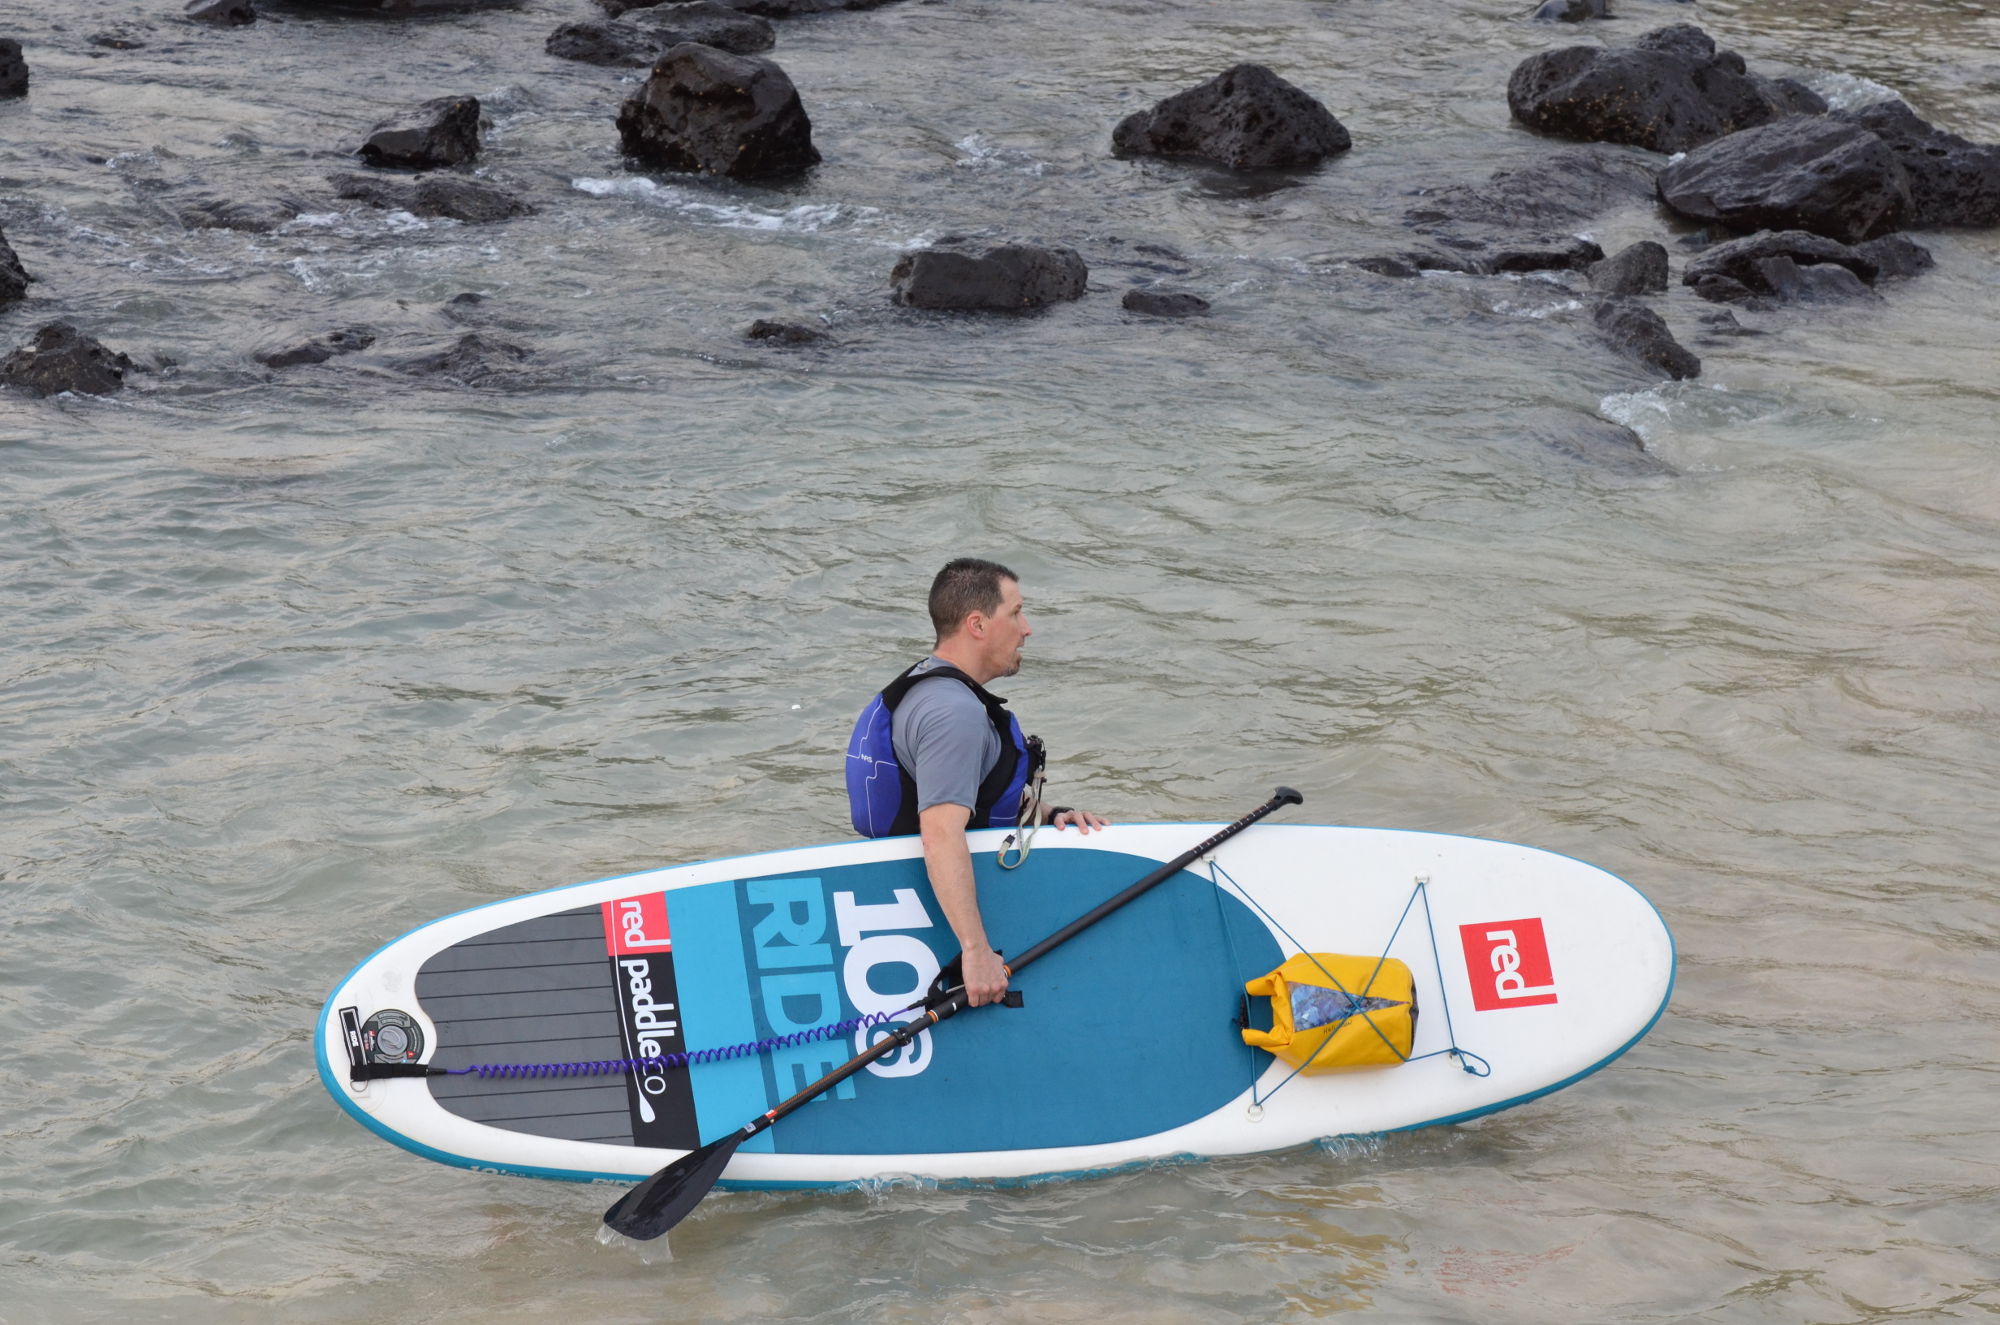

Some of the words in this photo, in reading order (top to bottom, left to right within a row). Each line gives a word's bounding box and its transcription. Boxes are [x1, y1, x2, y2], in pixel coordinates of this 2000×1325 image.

[620, 901, 671, 947] red
[746, 877, 856, 1102] RIDE
[1486, 929, 1557, 1000] red
[349, 1030, 360, 1047] RIDE
